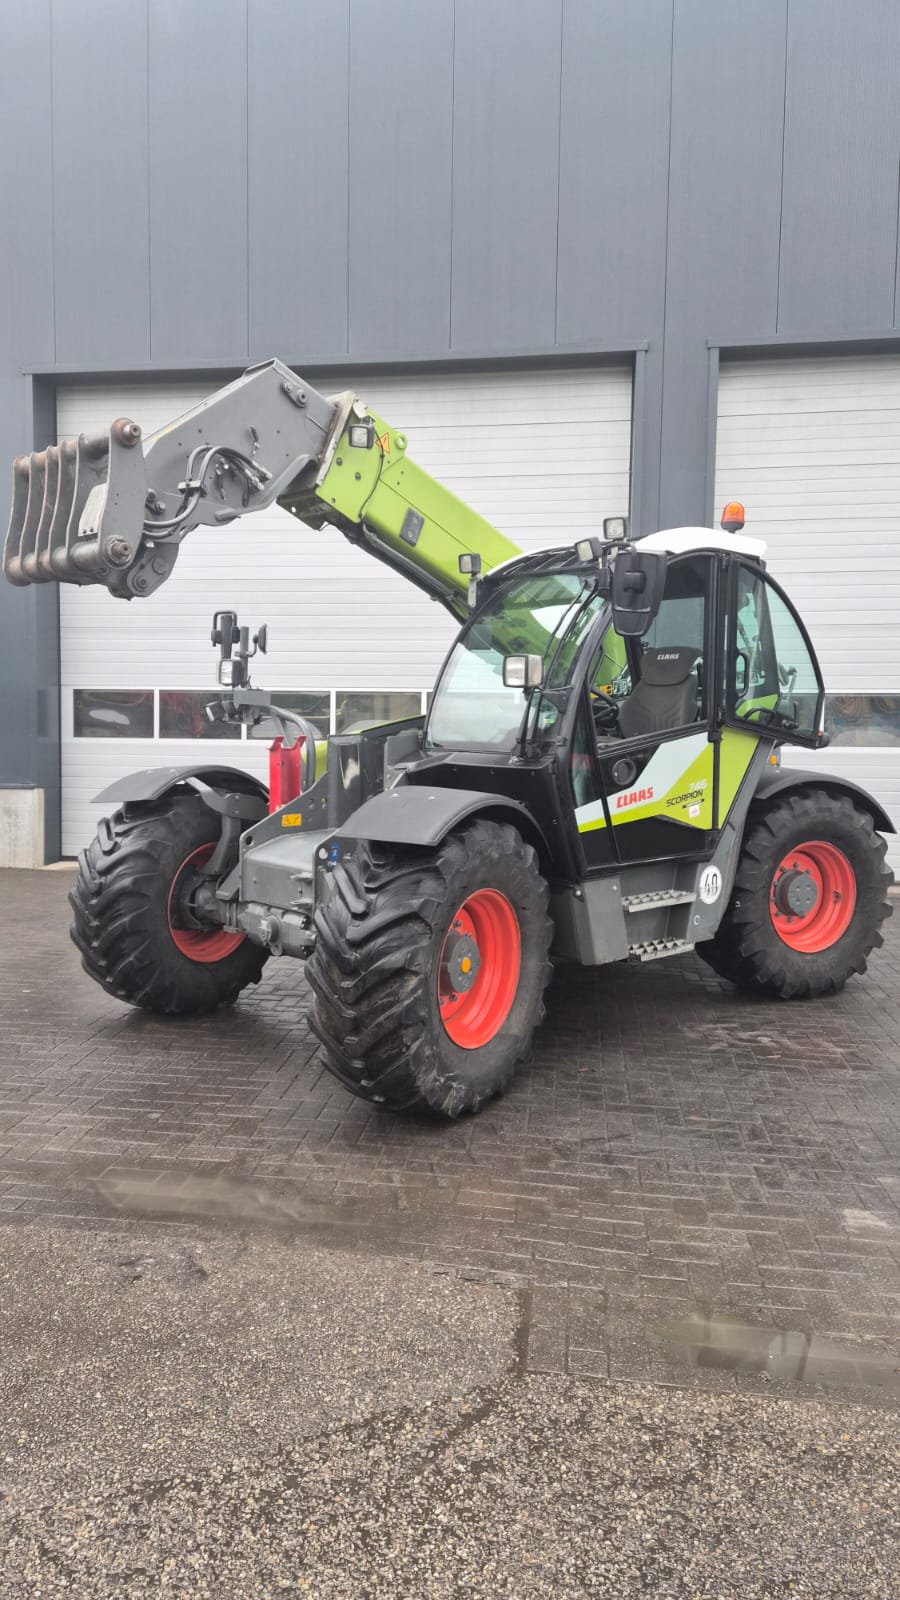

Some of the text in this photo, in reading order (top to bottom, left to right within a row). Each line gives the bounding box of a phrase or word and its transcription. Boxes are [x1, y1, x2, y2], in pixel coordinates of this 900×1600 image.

[616, 787, 654, 808] CLAAS
[665, 789, 704, 807] SCORPION
[704, 873, 718, 896] 40
